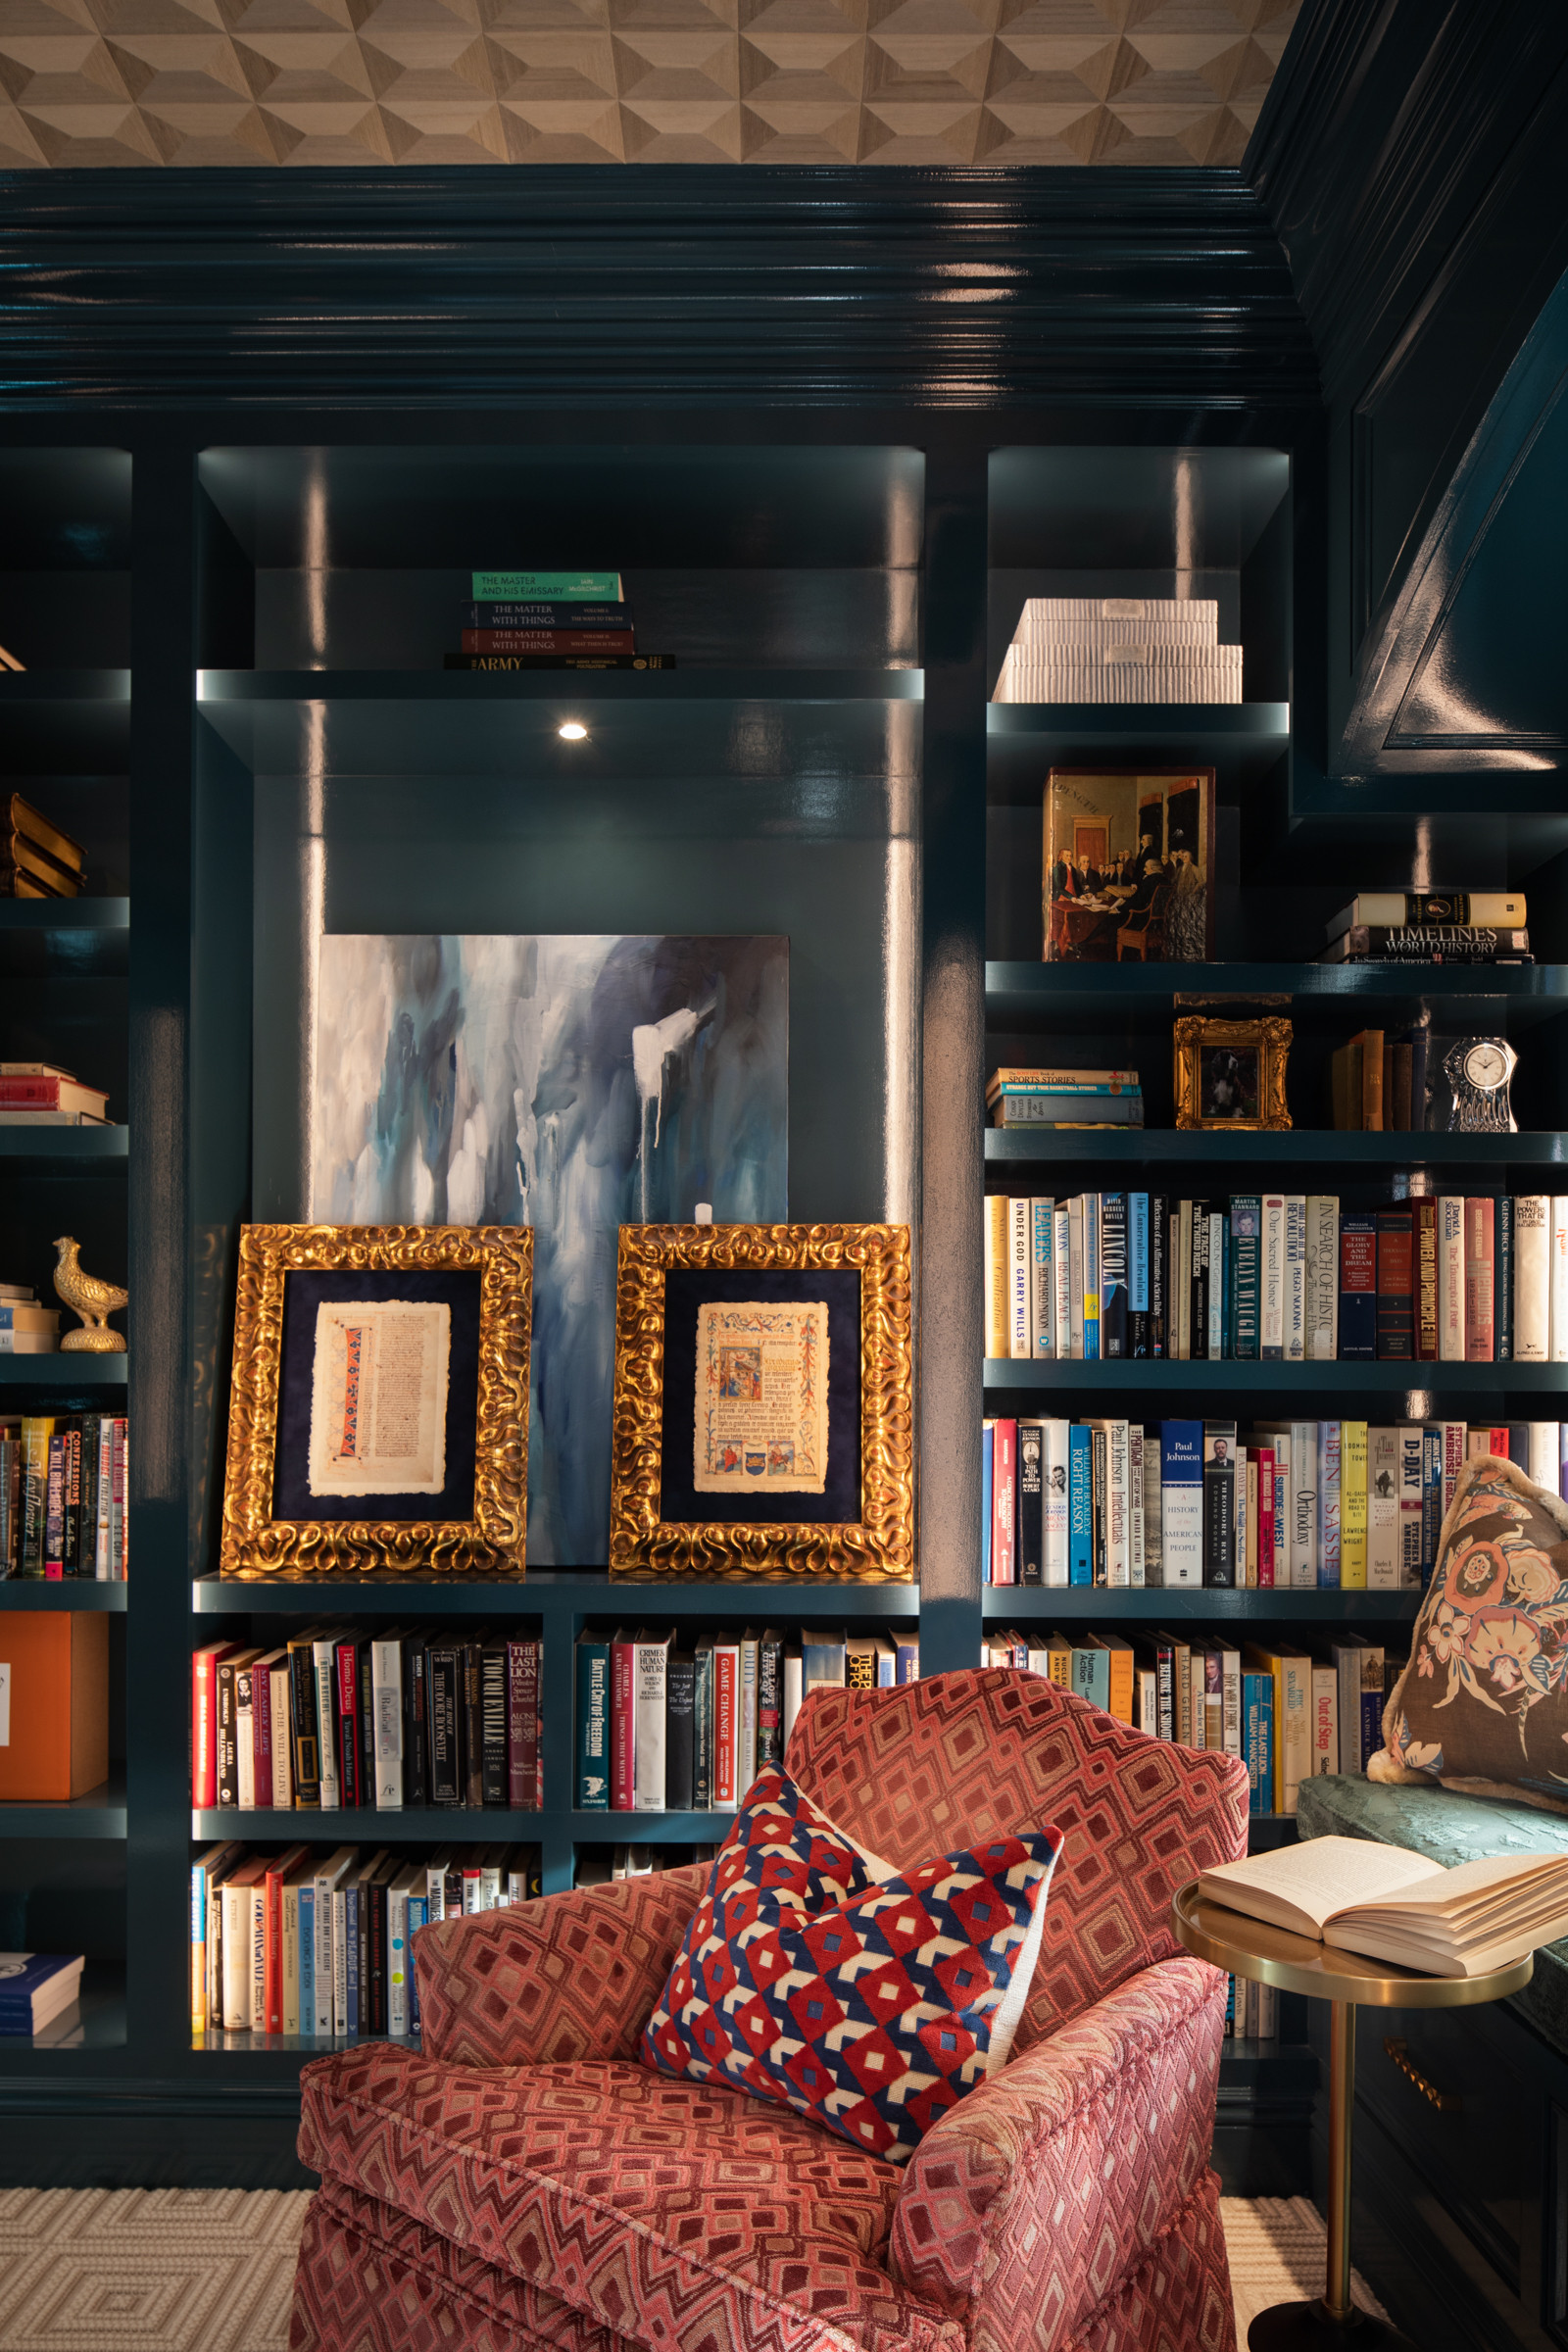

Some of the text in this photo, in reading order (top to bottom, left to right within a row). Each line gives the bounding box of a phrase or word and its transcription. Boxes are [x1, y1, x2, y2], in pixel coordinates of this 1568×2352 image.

[492, 615, 556, 625] WITH THINGS
[494, 605, 554, 613] THE MATTER
[492, 640, 556, 650] WITH THINGS
[478, 658, 524, 671] ARMY
[1389, 926, 1497, 942] TIMELINES
[1152, 1198, 1162, 1231] Reflections
[1500, 1200, 1509, 1254] GLENN BECK
[1035, 1204, 1052, 1263] LEADERS
[1057, 1219, 1069, 1251] NIXON
[1200, 1215, 1209, 1268] THE FACE OF
[1016, 1202, 1025, 1339] UNDER GOD GARRY WILLS
[1152, 1250, 1162, 1281] Affirmative
[1152, 1281, 1162, 1300] Action
[1152, 1301, 1162, 1317] Baby
[1111, 1425, 1126, 1485] Paul Johnson
[1166, 1452, 1200, 1463] Johnson
[1175, 1443, 1193, 1451] Paul
[1325, 1440, 1341, 1482] BEN
[1446, 1426, 1455, 1475] AMBROSE
[1403, 1439, 1421, 1489] D-DAY
[24, 1448, 43, 1538] Mayflower
[1072, 1448, 1084, 1535] RIGHT REASON
[1237, 1497, 1247, 1510] The
[1111, 1491, 1126, 1544] Intellectuals
[1237, 1511, 1247, 1529] Road
[1292, 1490, 1317, 1547] Orthodoxy
[1274, 1518, 1285, 1549] WEST
[1325, 1503, 1341, 1570] SASSE
[1237, 1537, 1247, 1563] Serfdom
[510, 1657, 537, 1667] LAST
[513, 1646, 536, 1657] THE
[744, 1648, 756, 1686] DUTY
[343, 1652, 353, 1711] Homo Deus
[510, 1667, 537, 1678] LION
[861, 1654, 872, 1681] THE
[1079, 1653, 1089, 1683] Action
[1087, 1652, 1097, 1684] Human
[482, 1655, 506, 1745] TOCQUEVILLE
[513, 1687, 534, 1695] Spencer
[719, 1657, 730, 1741] GAME CHANGE
[761, 1680, 769, 1692] OF
[761, 1695, 769, 1705] Z
[445, 1695, 455, 1737] THE RISE OF
[591, 1658, 606, 1757] BATTLE CRY OF FREEDOM
[1315, 1696, 1333, 1750] Out of Step
[1258, 1720, 1267, 1775] THE LAST LION
[322, 1892, 331, 1904] WHY
[485, 1884, 494, 1899] The
[270, 1878, 280, 1960] Ambling into History
[322, 1905, 331, 1924] ZEBRAS
[303, 1927, 312, 1961] EVOLVING
[322, 1925, 331, 1941] DON'T
[397, 1929, 405, 1937] to
[322, 1951, 331, 1972] ULCERS
[303, 1972, 312, 1989] EDEN
